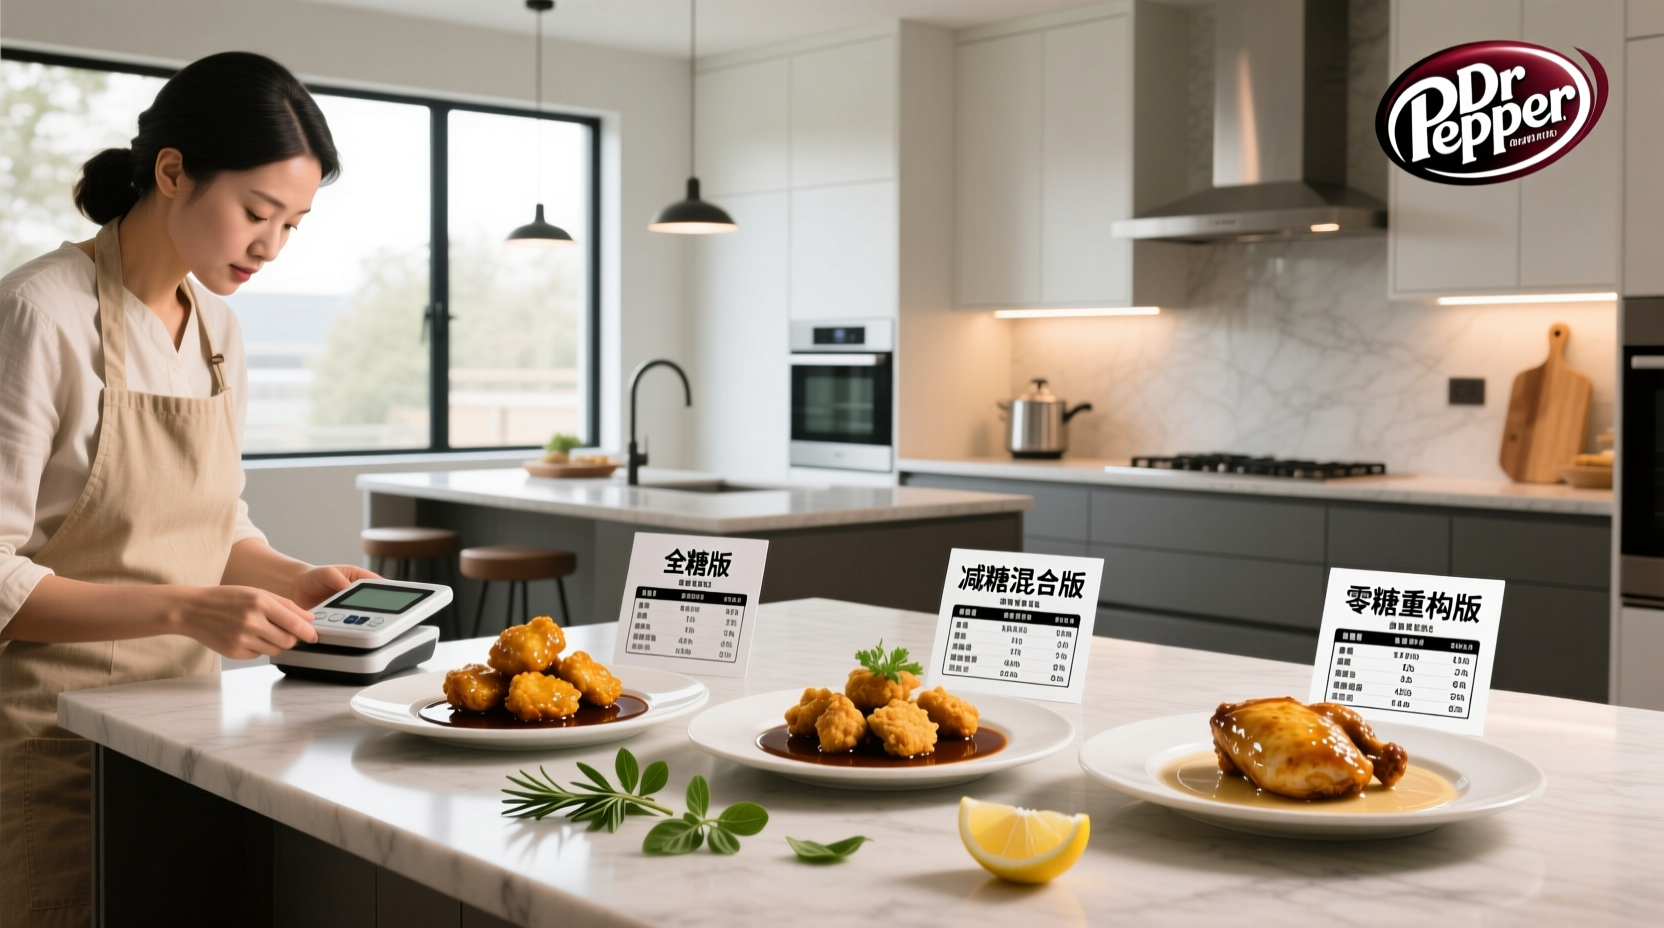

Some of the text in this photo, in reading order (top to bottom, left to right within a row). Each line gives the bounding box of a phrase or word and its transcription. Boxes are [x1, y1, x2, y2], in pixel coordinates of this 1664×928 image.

[663, 548, 733, 578] 全糖版
[957, 563, 1087, 599] 减糖混合版
[1345, 585, 1483, 624] 零糖重构版
